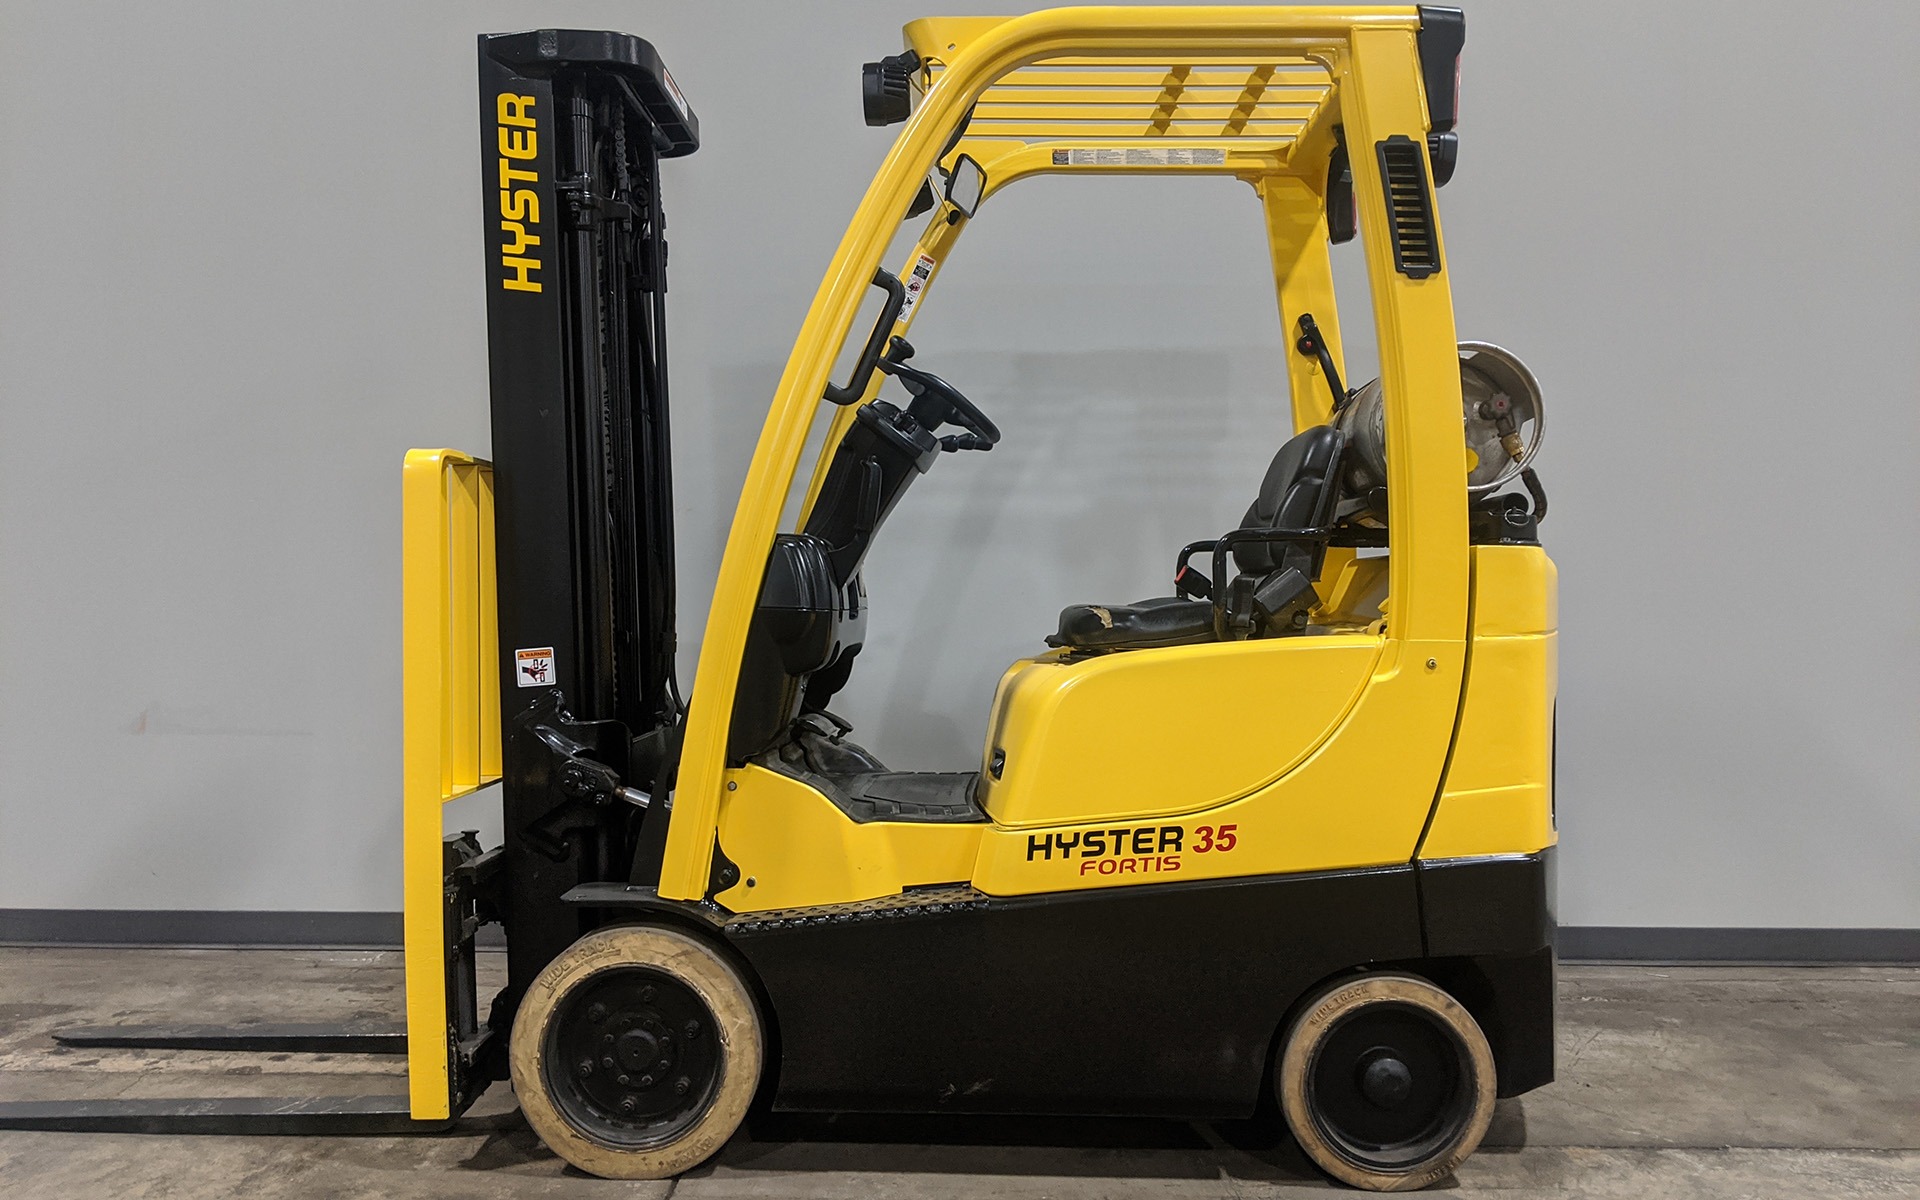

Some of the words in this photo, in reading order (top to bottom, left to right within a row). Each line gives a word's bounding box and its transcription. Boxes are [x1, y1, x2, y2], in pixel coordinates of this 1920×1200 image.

[497, 92, 542, 293] HYSTER
[1026, 826, 1184, 861] HYSTER
[1192, 824, 1238, 854] 35
[1080, 856, 1181, 876] FORTIS
[540, 962, 571, 989] WIDE
[573, 940, 616, 962] TRACK
